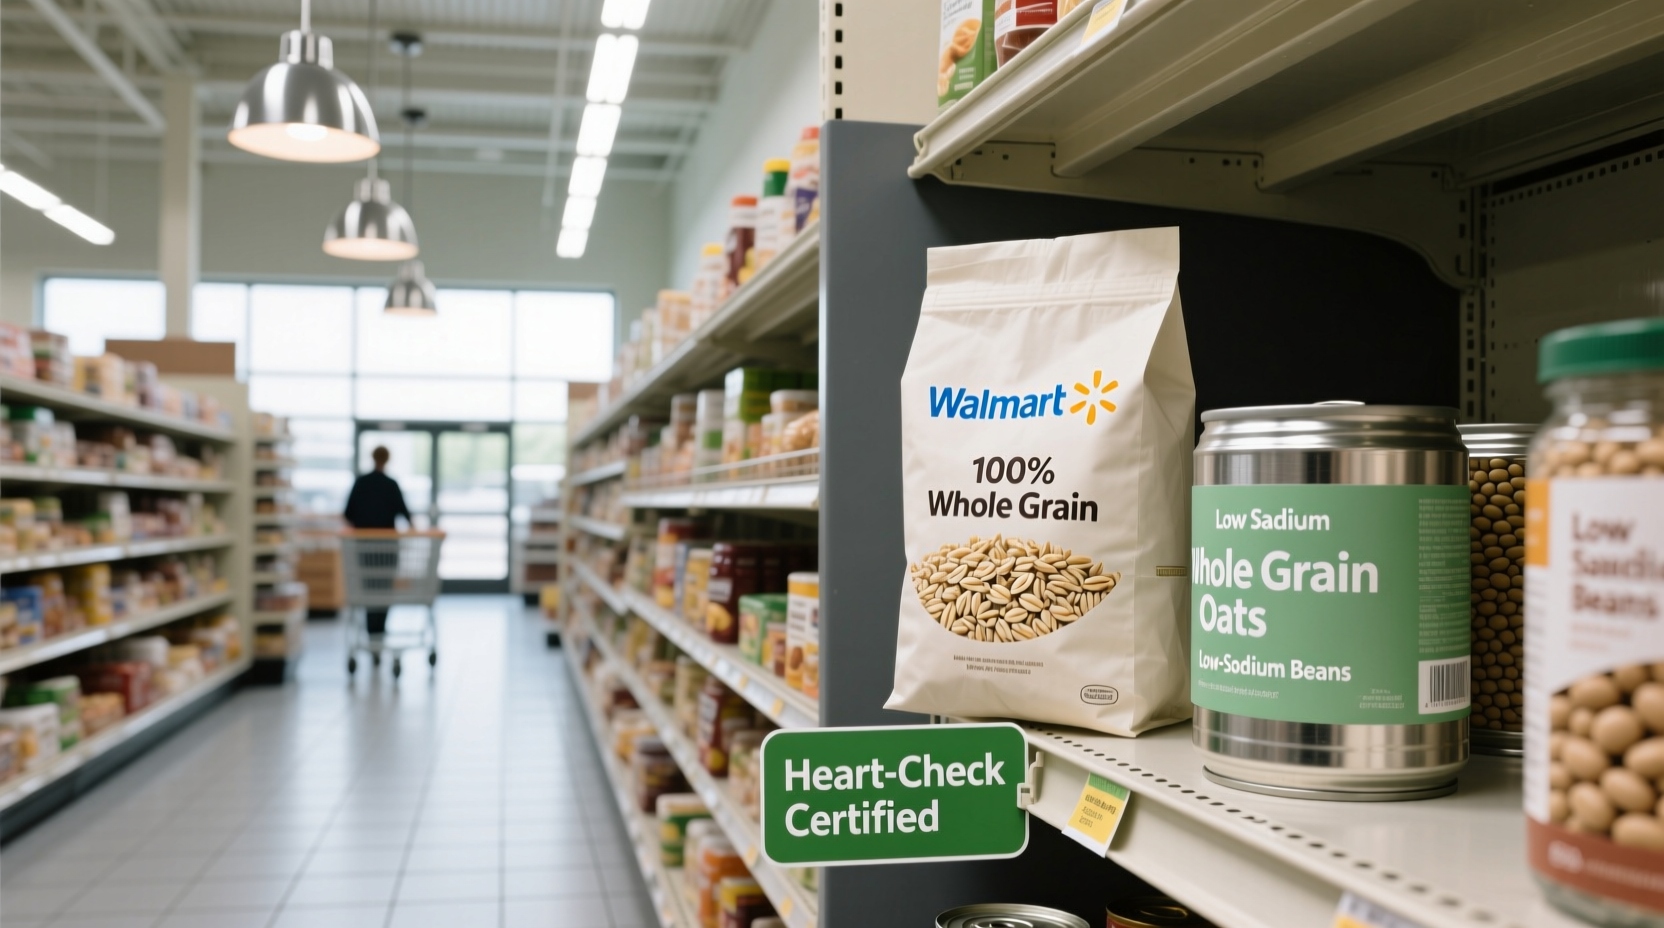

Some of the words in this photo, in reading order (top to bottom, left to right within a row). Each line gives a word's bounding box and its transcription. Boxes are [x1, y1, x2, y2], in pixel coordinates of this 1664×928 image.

[929, 384, 1067, 420] Walmart
[972, 456, 1055, 485] 100%
[928, 490, 1013, 519] Whole
[1018, 491, 1099, 522] Grain
[1216, 508, 1247, 530] Low
[1250, 507, 1330, 531] Sadium
[1572, 513, 1634, 542] Low
[1261, 549, 1378, 593] Grain
[1199, 593, 1268, 638] Oats
[1290, 659, 1352, 682] Beans
[785, 751, 1006, 792] Heart-Check
[785, 799, 939, 837] Certified
